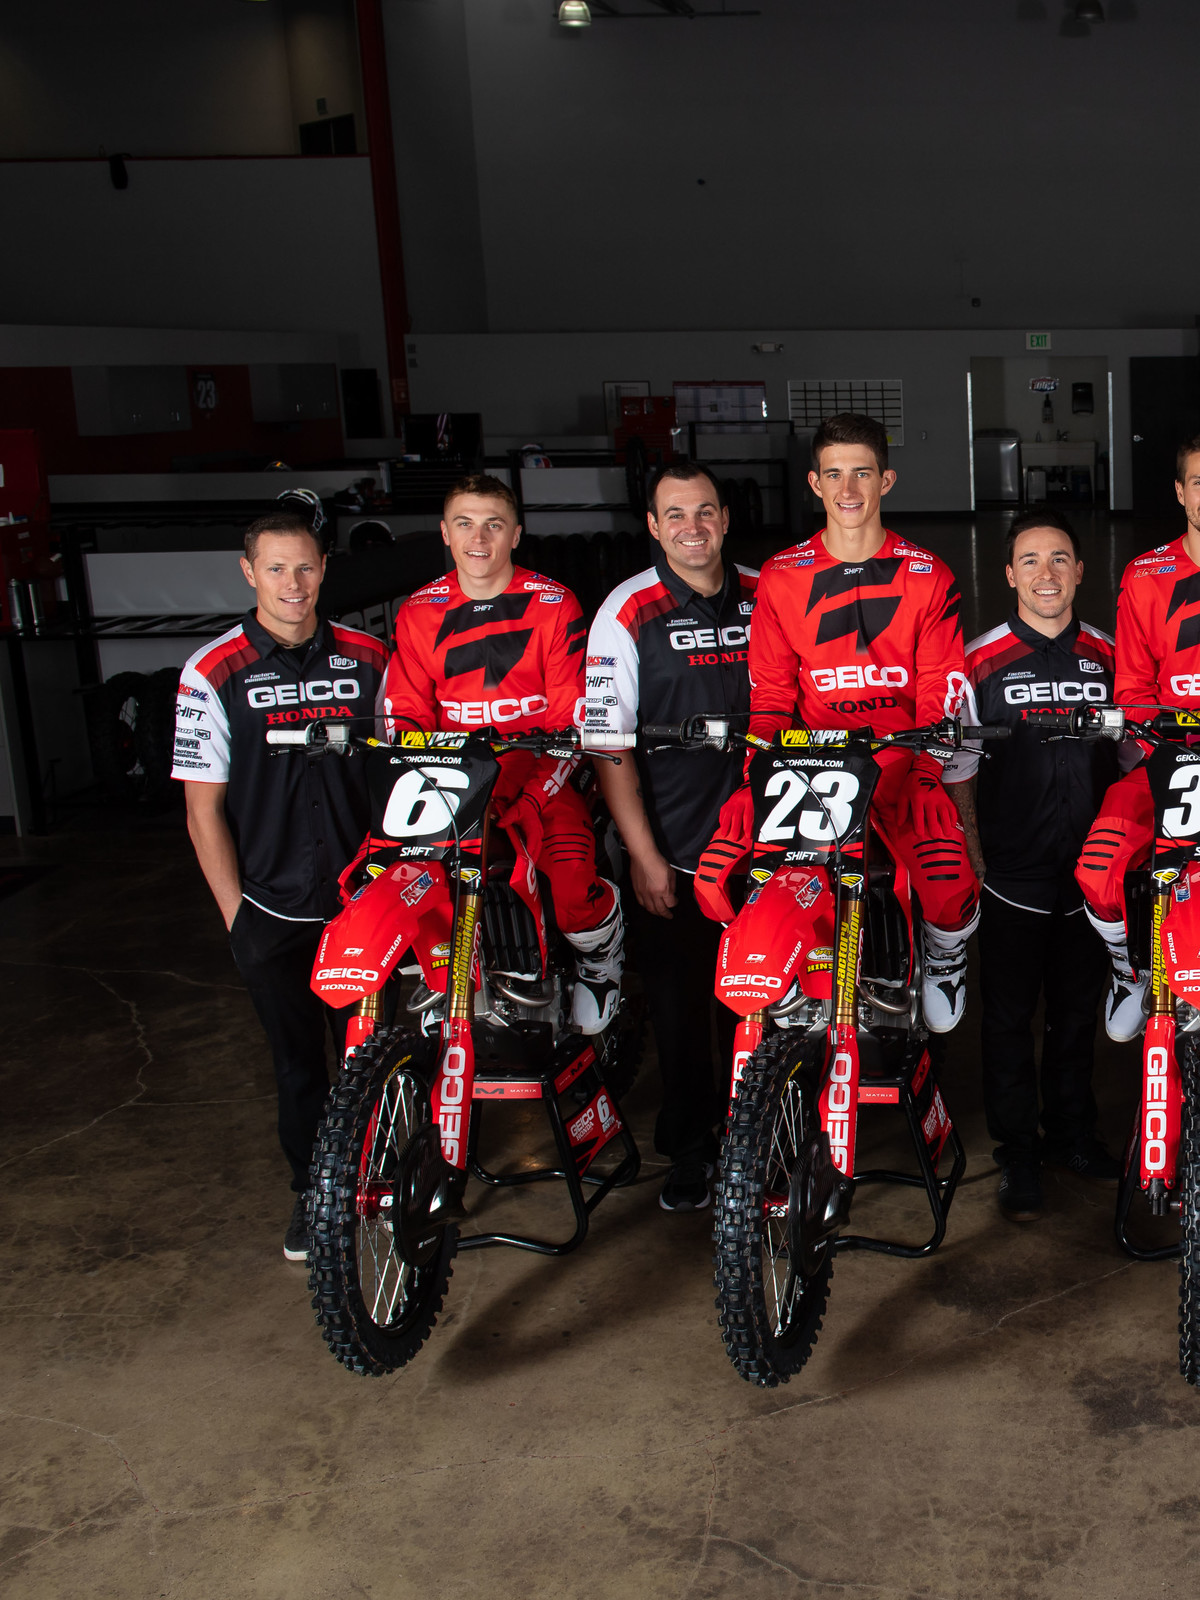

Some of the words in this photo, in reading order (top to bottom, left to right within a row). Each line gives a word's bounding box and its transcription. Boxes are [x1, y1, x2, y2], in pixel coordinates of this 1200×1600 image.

[1030, 335, 1048, 348] EXIT
[198, 380, 216, 409] 23
[774, 549, 816, 561] GEICO
[893, 548, 934, 561] GEICO
[1134, 556, 1176, 566] GEICO
[844, 567, 864, 575] SHIFT
[911, 563, 931, 572] 100%
[1134, 565, 1176, 577] AMSOIL
[411, 586, 449, 598] GEICO
[524, 582, 565, 593] GEICO
[542, 594, 561, 602] 100%
[332, 658, 354, 667] 100%
[687, 651, 750, 666] HOND
[1083, 661, 1103, 671] 100%
[810, 664, 909, 692] GEICO
[247, 679, 360, 709] GEICO
[1004, 682, 1107, 705] GEICO
[266, 705, 355, 725] HONDA
[441, 695, 549, 724] GEICO
[824, 696, 901, 714] HOND
[382, 767, 470, 837] 6
[758, 770, 860, 843] 23
[400, 847, 434, 857] SHIFT
[785, 850, 818, 861] SHIFT
[319, 933, 330, 964] DUNLOP
[380, 934, 402, 968] DUNLOP
[455, 906, 476, 997] Connection
[783, 941, 802, 975] DUNLOP
[836, 921, 850, 987] Factory
[843, 911, 860, 1004] Connection
[1151, 904, 1163, 996] Connection
[1167, 932, 1177, 964] DUNLOP
[316, 968, 379, 981] GEICO
[720, 974, 782, 988] GEICO
[320, 984, 366, 992] HONDA
[725, 990, 770, 999] HONDA
[439, 1046, 466, 1167] GEICO
[597, 1094, 610, 1123] 6
[826, 1052, 852, 1174] GEICO
[1145, 1046, 1168, 1171] GEICO
[570, 1107, 595, 1138] GEICO
